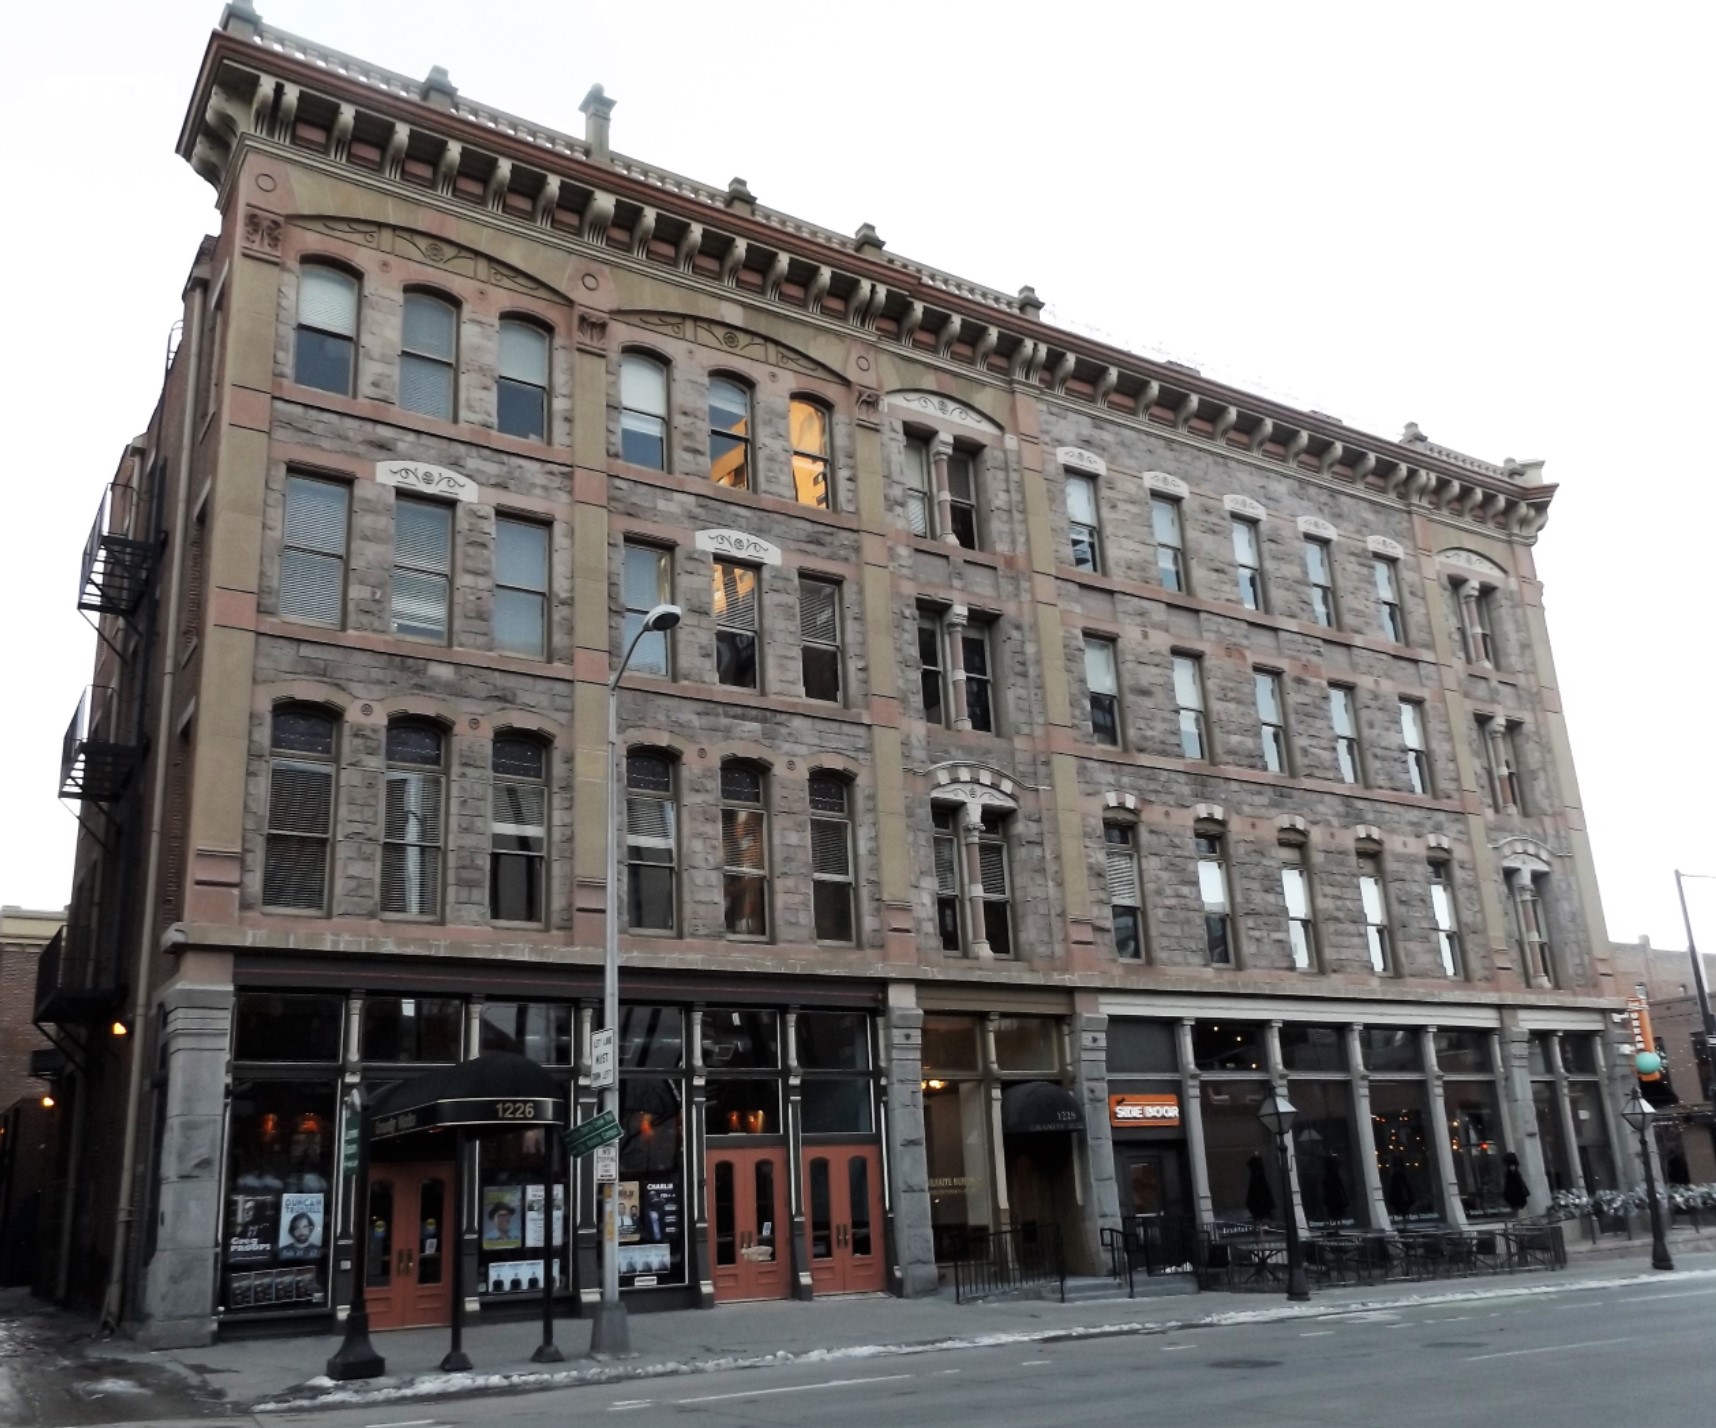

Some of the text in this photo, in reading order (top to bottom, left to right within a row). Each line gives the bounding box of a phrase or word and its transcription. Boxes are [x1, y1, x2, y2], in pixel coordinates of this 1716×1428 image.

[603, 1035, 612, 1046] LANE
[595, 1052, 609, 1065] MUST
[496, 1102, 534, 1118] 1226
[1115, 1105, 1180, 1118] SIDE DOOR
[285, 1198, 322, 1207] DUNCAN
[231, 1237, 258, 1245] Greg
[230, 1243, 271, 1252] PROOPS
